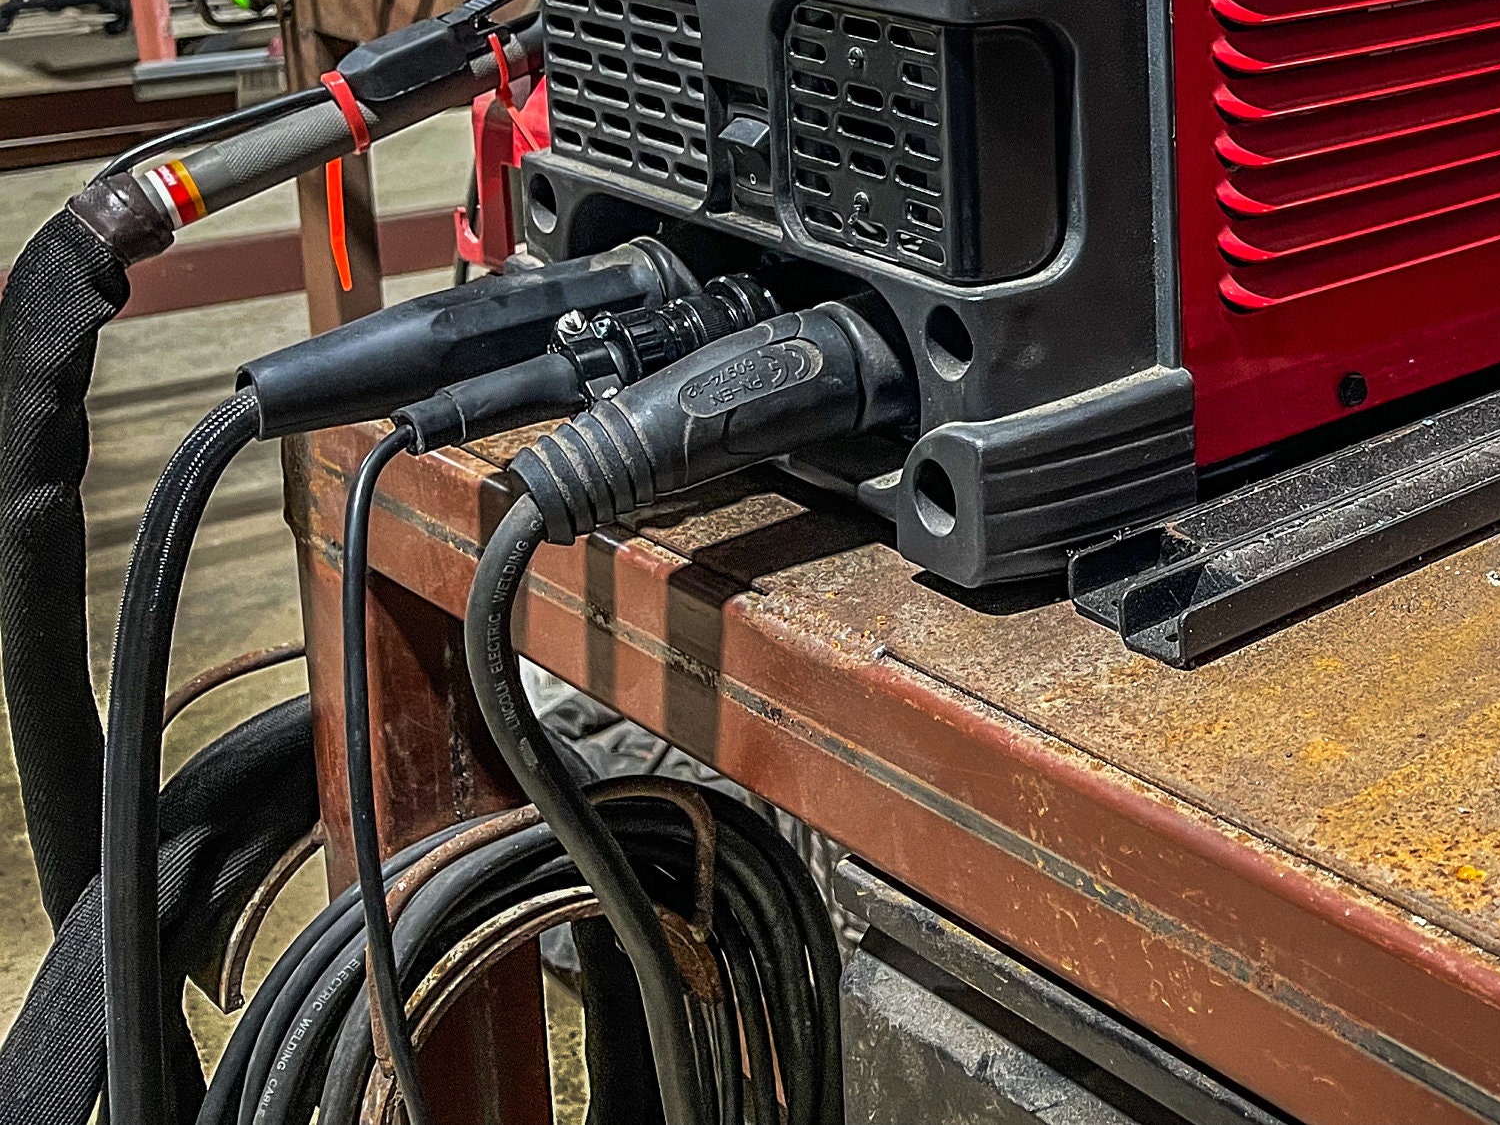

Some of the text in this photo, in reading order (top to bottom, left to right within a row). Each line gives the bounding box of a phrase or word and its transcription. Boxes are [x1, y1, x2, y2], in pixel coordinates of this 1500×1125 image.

[709, 374, 765, 406] PN-EN
[487, 539, 530, 728] LINCOLN ELECTRIC WELDING
[258, 958, 361, 1118] ELECTRIC WELDING CABLE
